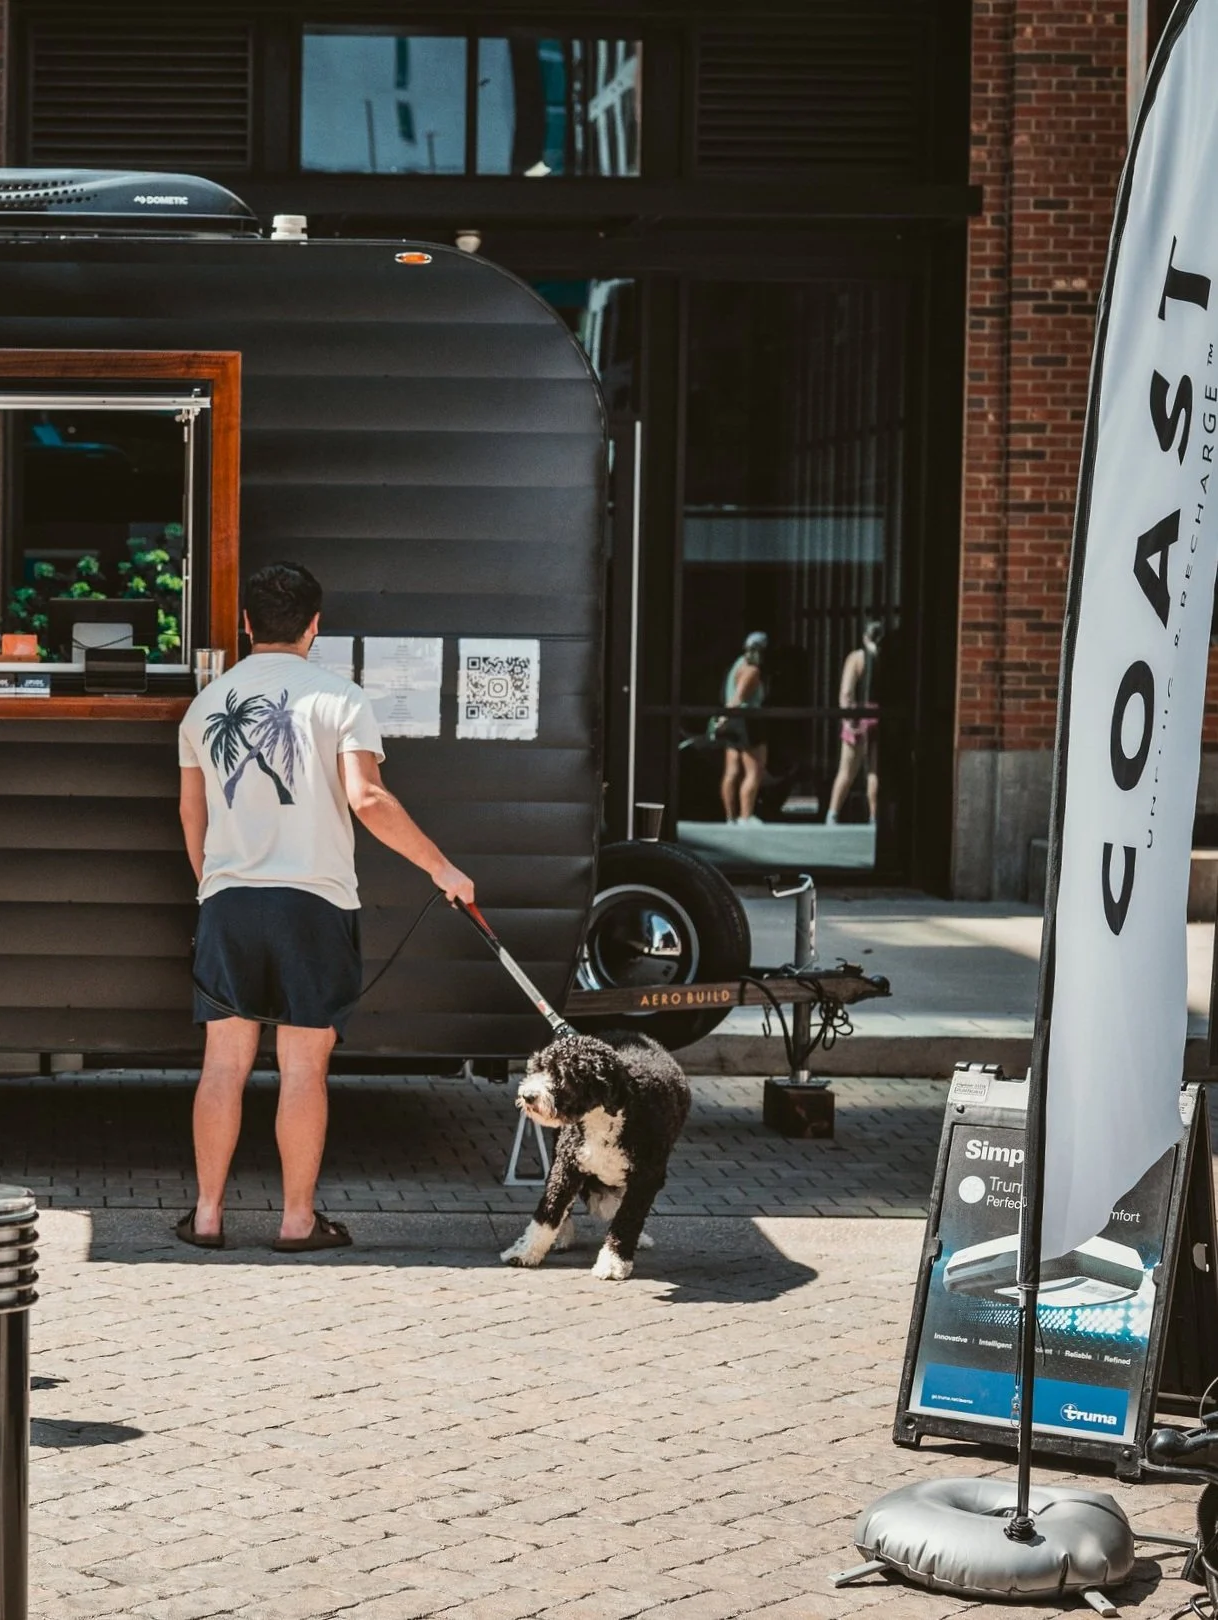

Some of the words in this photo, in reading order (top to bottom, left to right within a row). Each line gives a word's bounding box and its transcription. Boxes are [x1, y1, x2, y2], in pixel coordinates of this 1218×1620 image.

[147, 196, 188, 205] DOMETIC
[1101, 235, 1212, 936] COAST
[640, 993, 682, 1006] AERO
[686, 990, 730, 1003] BUILD
[965, 1139, 1025, 1167] Simp
[989, 1175, 1023, 1193] Trum
[986, 1195, 1021, 1210] Perfec
[1111, 1208, 1141, 1223] mfort
[934, 1333, 968, 1343] Innovative
[979, 1338, 1013, 1349] Intelligent
[1065, 1350, 1092, 1360] Reliable
[1104, 1355, 1131, 1365] Refined
[1062, 1404, 1118, 1425] truma
